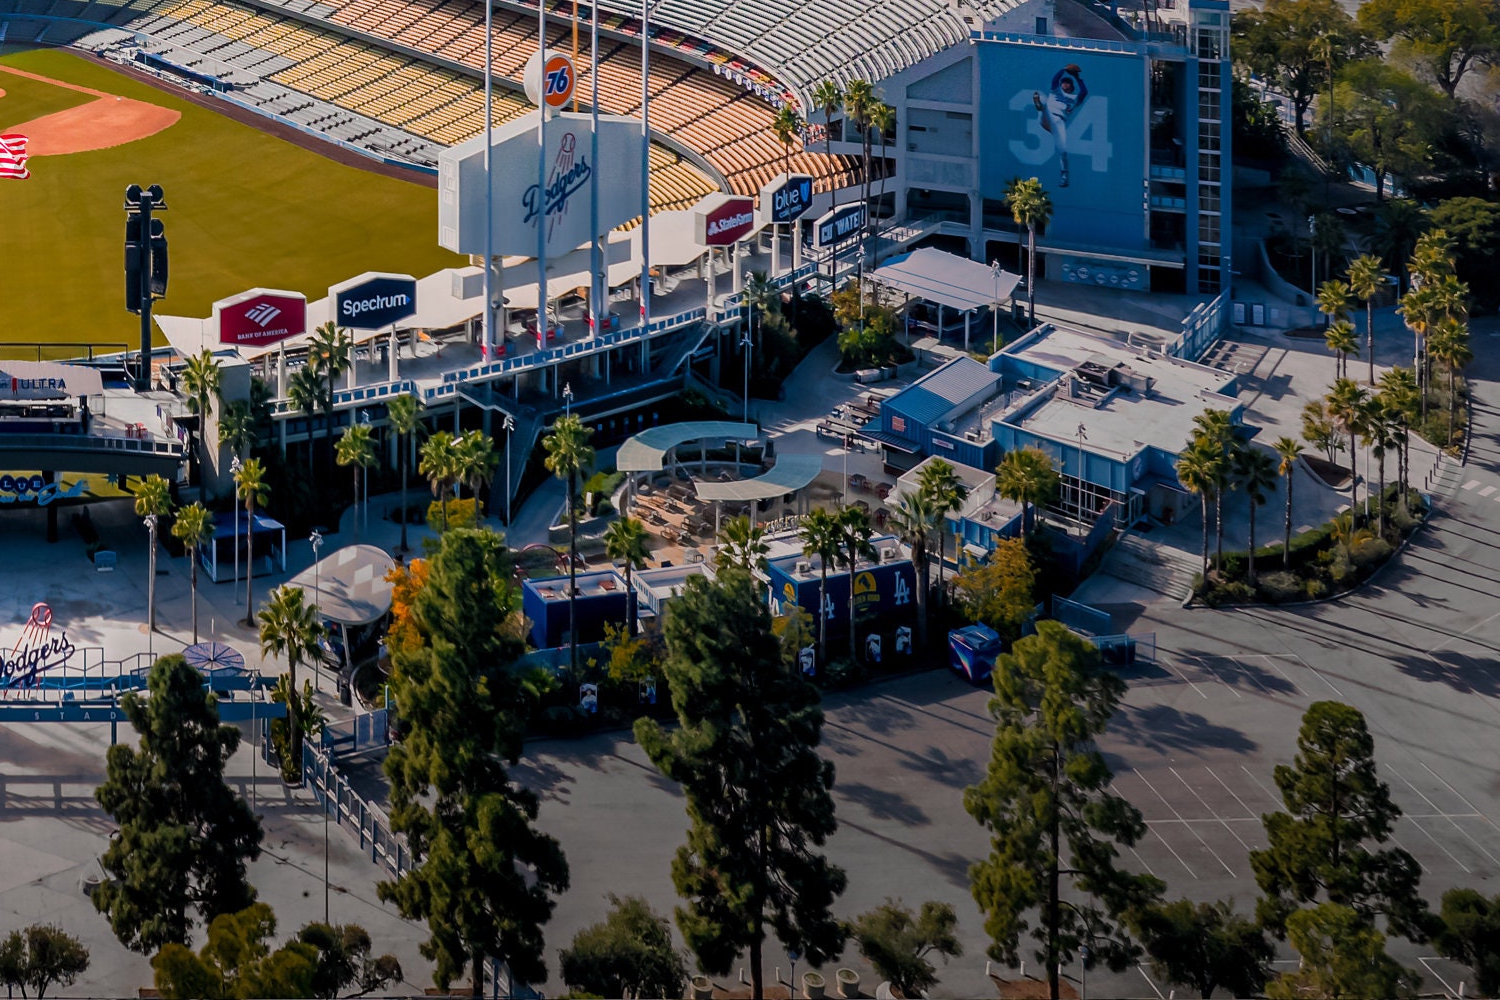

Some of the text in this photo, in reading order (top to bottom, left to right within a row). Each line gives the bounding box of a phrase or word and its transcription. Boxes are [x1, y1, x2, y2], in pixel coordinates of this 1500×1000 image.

[545, 66, 569, 95] 76
[1008, 88, 1113, 173] 34
[343, 293, 407, 317] Spectrum
[237, 332, 253, 340] BANK
[262, 328, 288, 337] AMERICA
[21, 378, 67, 390] ULTRA
[894, 571, 910, 605] LA
[34, 707, 117, 721] STAD
